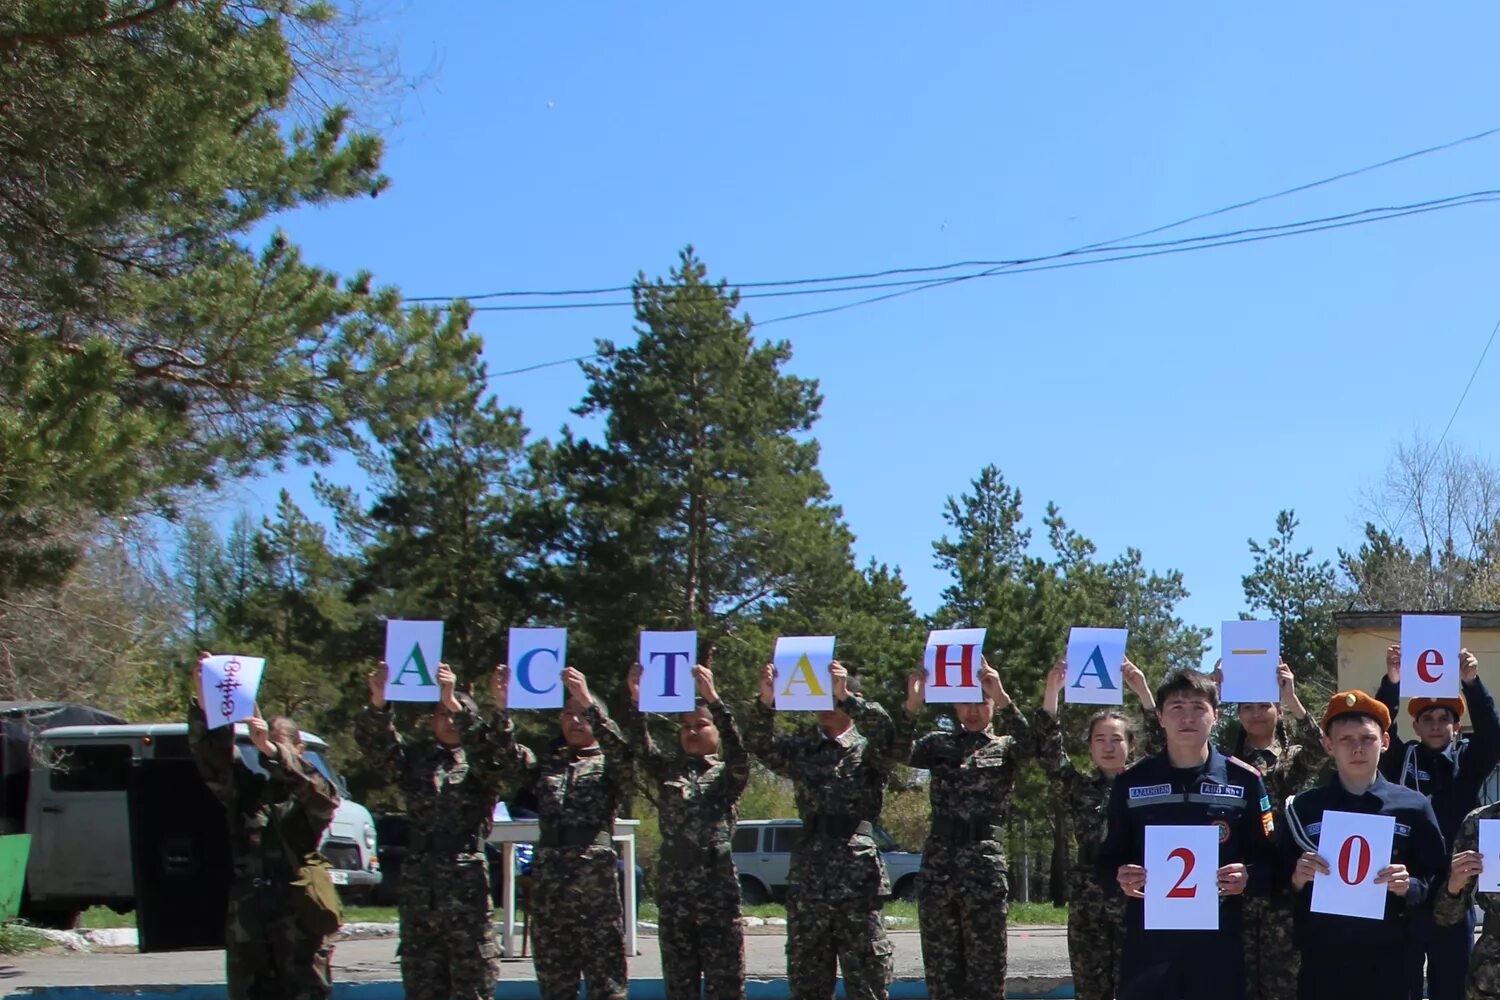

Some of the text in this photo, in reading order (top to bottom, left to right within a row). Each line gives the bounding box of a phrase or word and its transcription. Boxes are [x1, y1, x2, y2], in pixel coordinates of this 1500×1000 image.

[391, 642, 437, 687] А
[516, 647, 559, 694] С
[649, 651, 690, 697] Т
[781, 653, 827, 697] А
[930, 643, 981, 688] Н
[1071, 644, 1118, 690] А
[1416, 649, 1444, 684] е
[1131, 784, 1170, 798] KAZAKHSTAN
[1165, 847, 1198, 899] 2
[1337, 834, 1372, 886] 0
